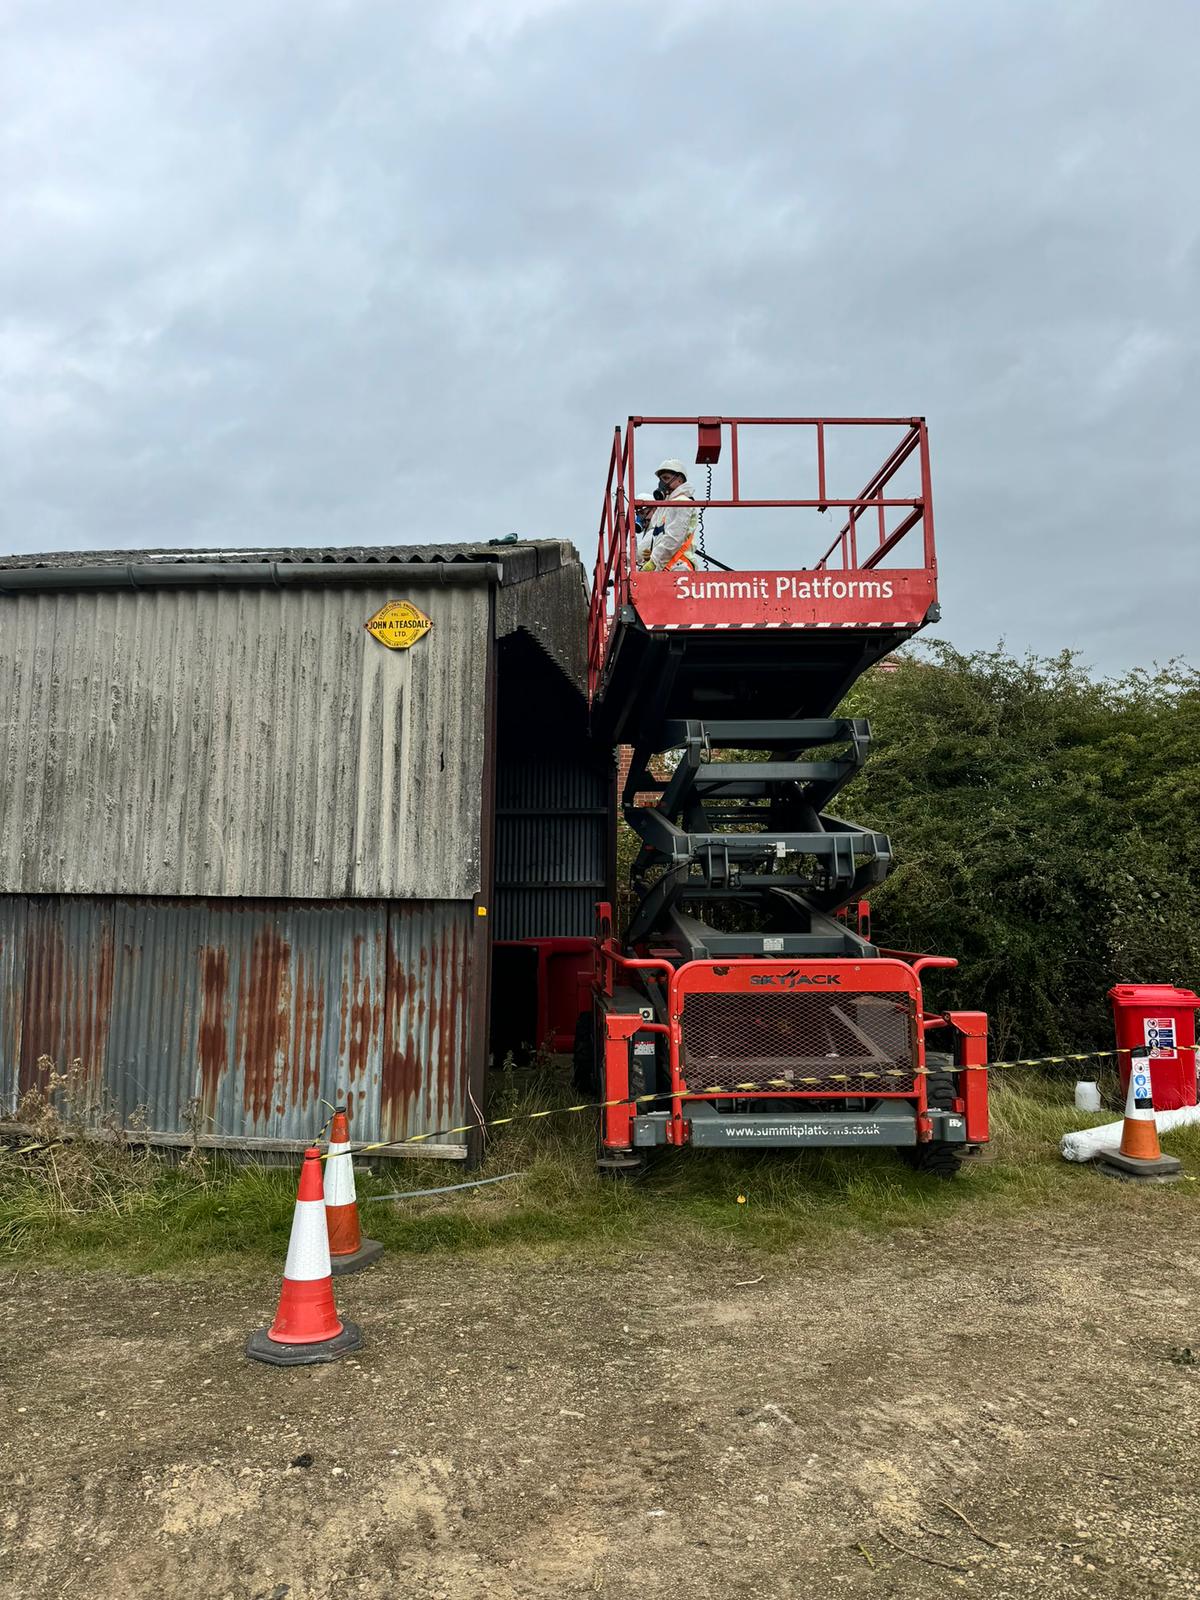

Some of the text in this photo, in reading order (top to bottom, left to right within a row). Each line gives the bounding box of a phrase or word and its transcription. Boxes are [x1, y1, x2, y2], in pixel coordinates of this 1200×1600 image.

[676, 576, 893, 599] Summit Platforms
[369, 620, 387, 630] JOHN
[750, 968, 841, 988] SKYJACK
[725, 1123, 881, 1138] www.summitplatfoms.co.uk
